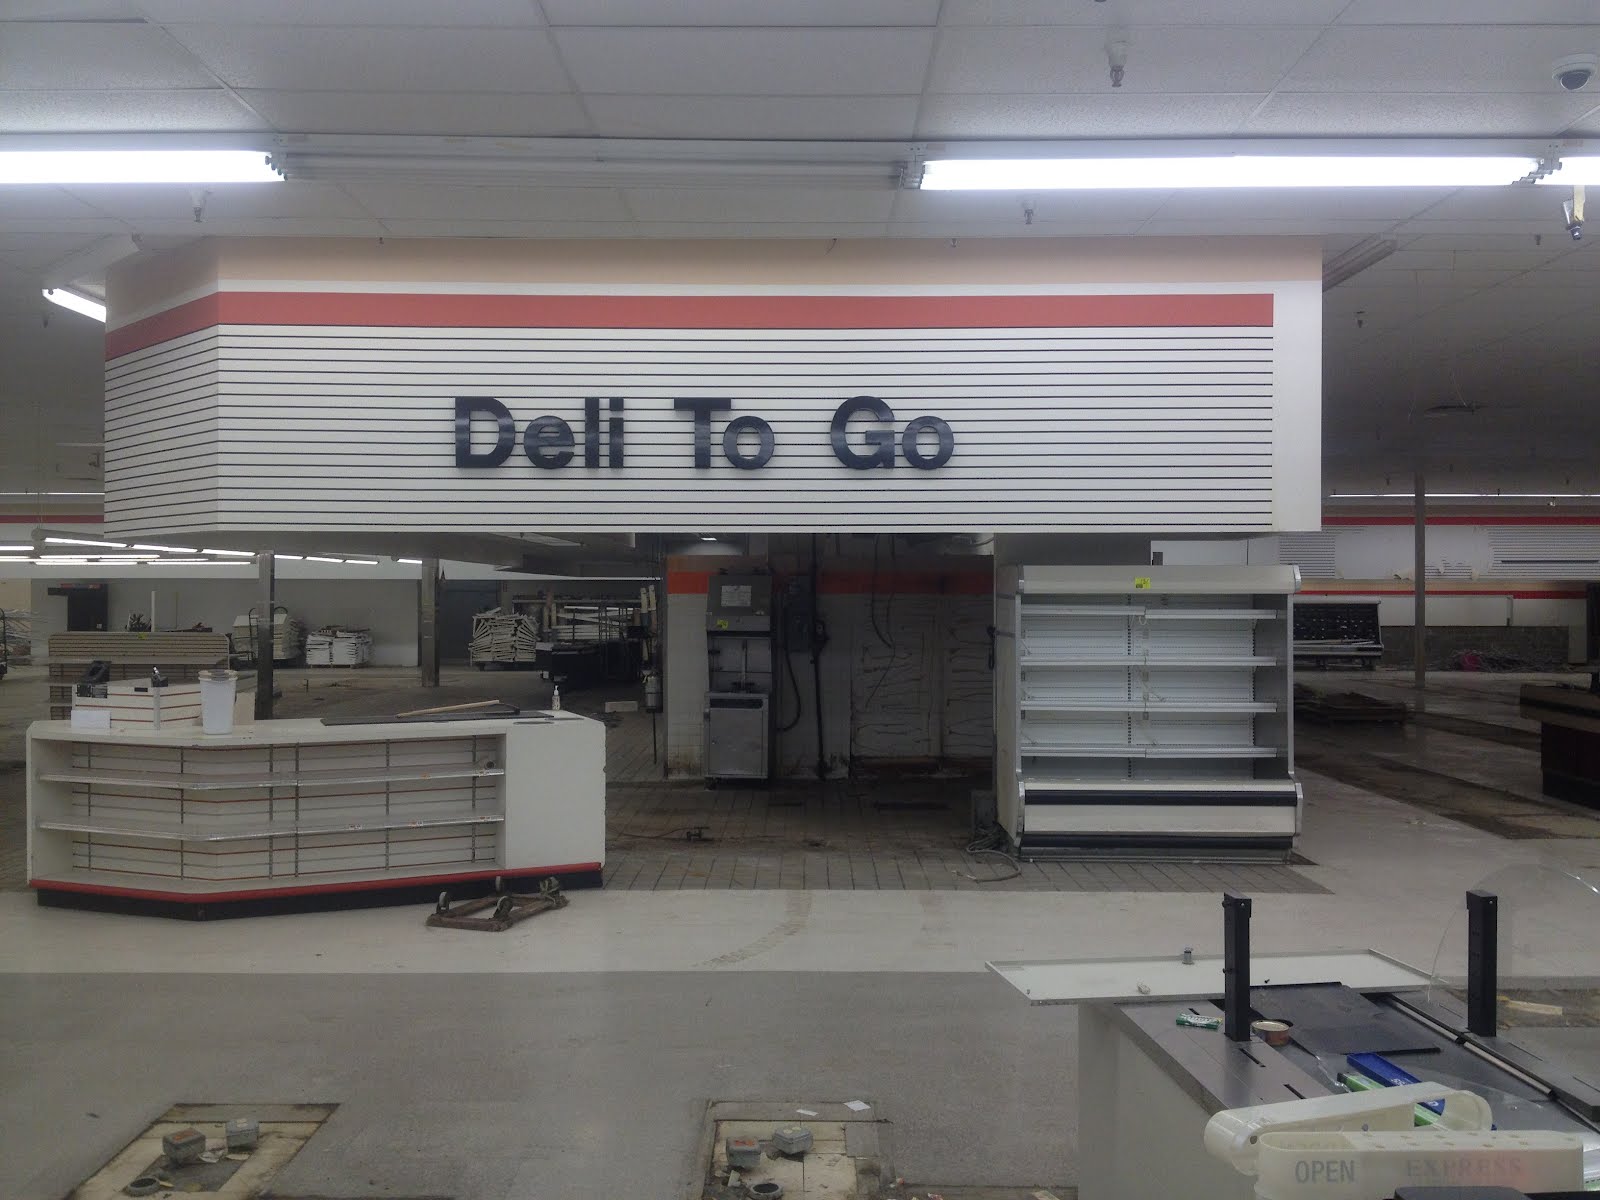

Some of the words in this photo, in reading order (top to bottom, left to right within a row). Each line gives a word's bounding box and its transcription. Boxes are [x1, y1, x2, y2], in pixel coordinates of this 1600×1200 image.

[455, 396, 624, 470] Deli
[673, 397, 775, 471] To
[830, 395, 955, 471] Go
[1294, 1159, 1356, 1184] OPEN
[1406, 1157, 1522, 1178] EXPRESS
